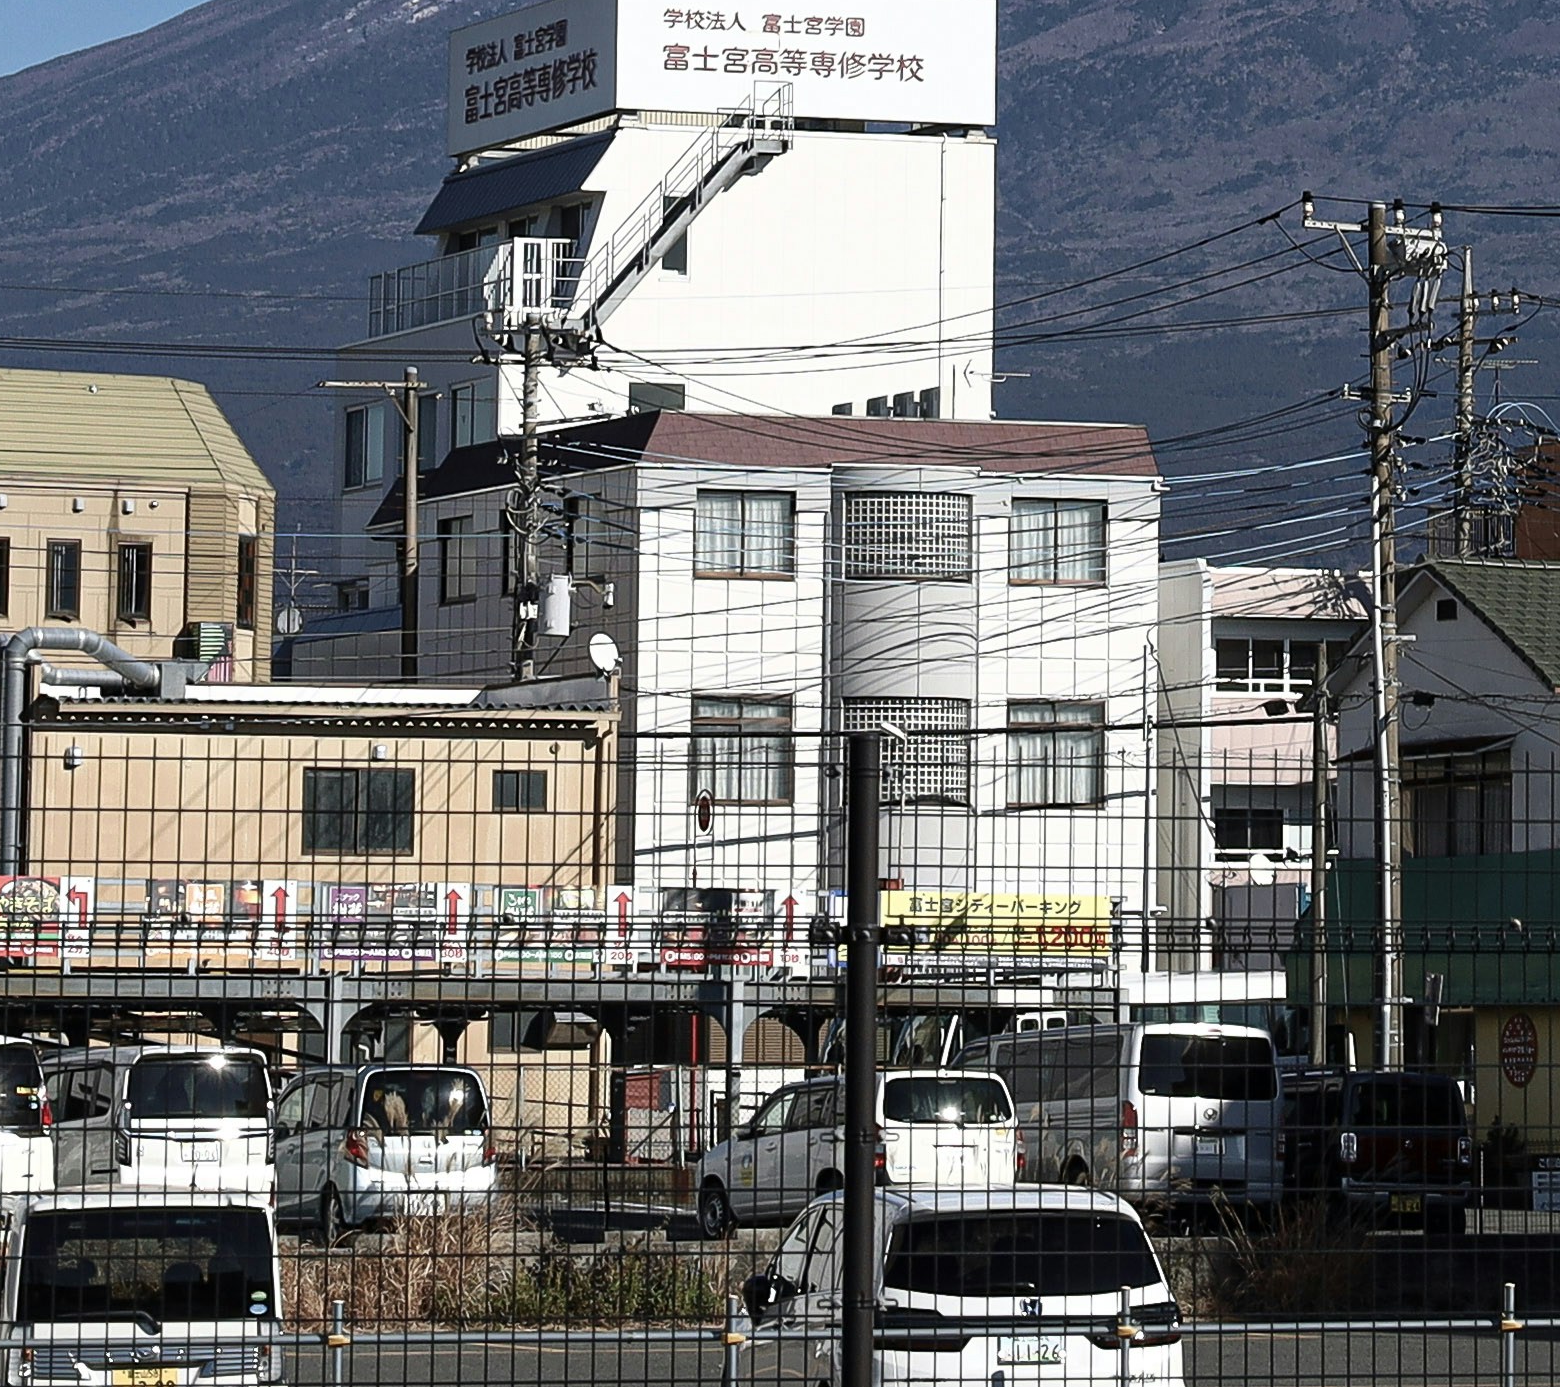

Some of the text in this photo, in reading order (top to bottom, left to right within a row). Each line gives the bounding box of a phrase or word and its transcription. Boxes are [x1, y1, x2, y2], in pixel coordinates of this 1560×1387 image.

[663, 8, 865, 37] 学校法人 富士宮学園
[466, 39, 508, 75] 学校法人
[663, 43, 924, 82] 富士宮高等専修学校
[465, 48, 598, 124] 富士宮高等専修学校
